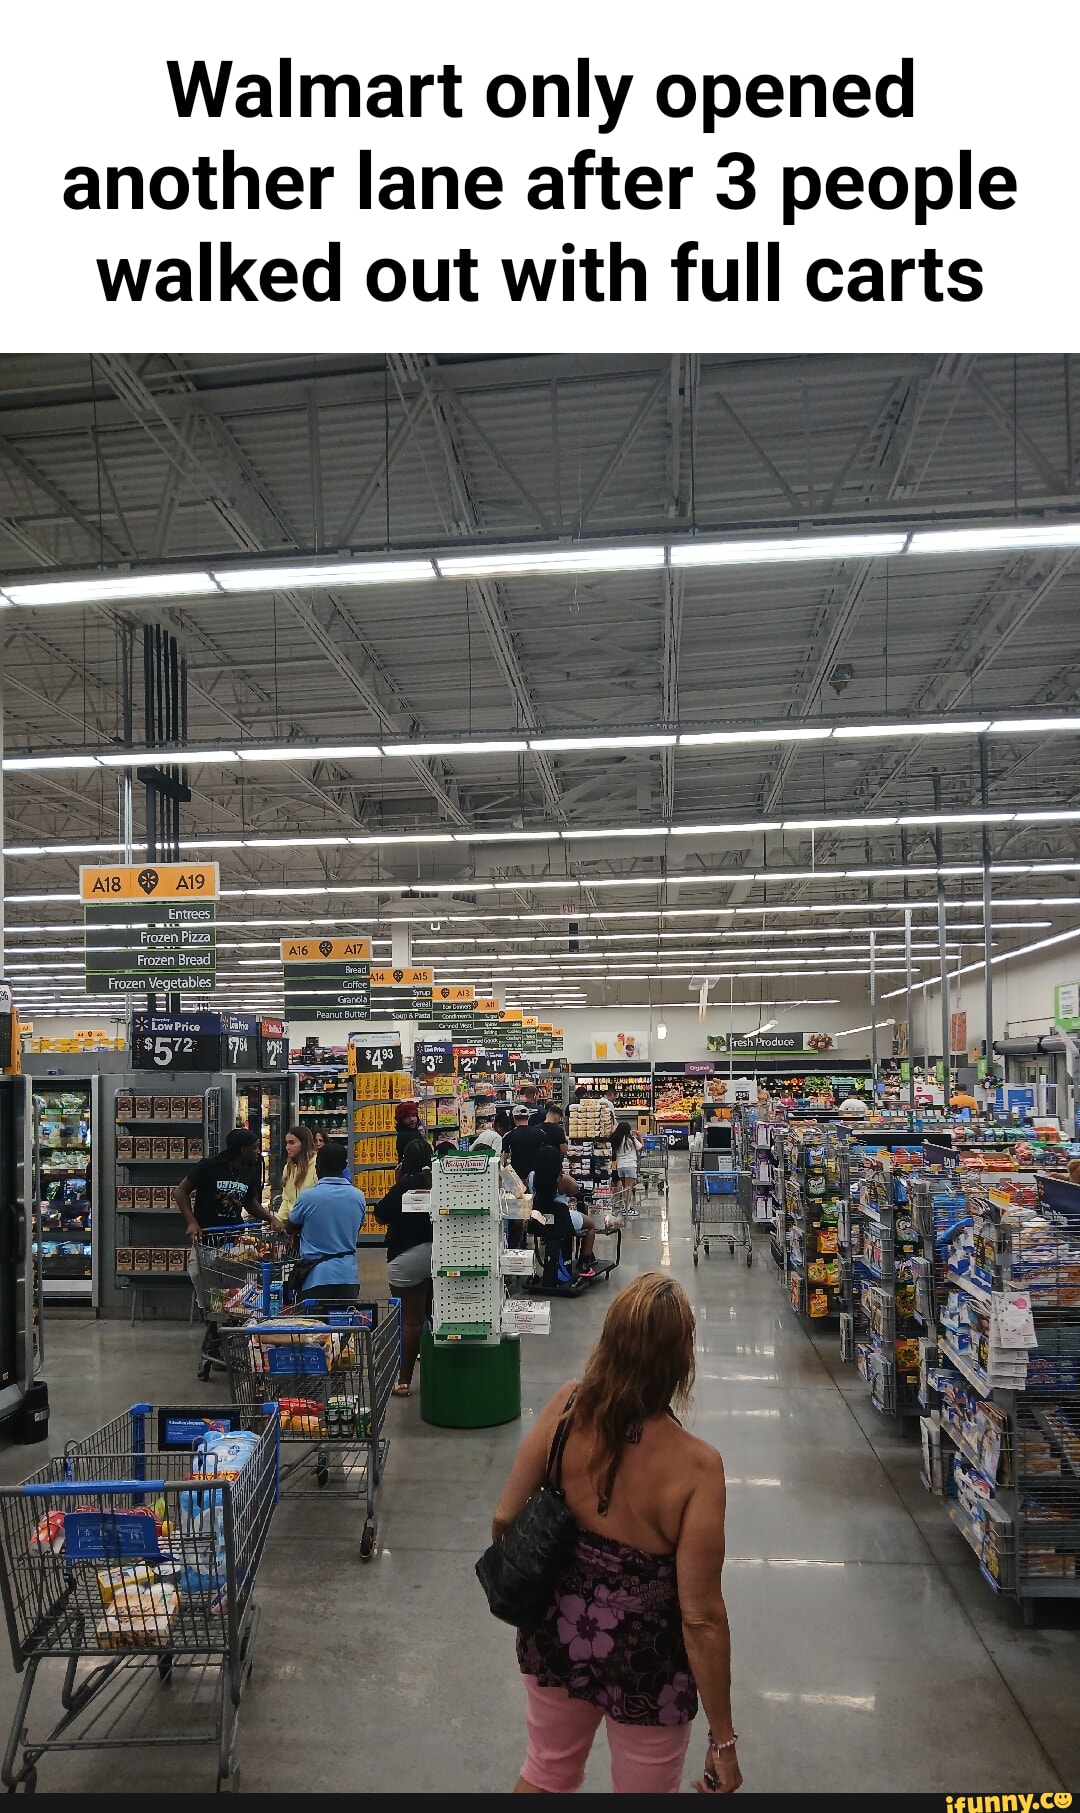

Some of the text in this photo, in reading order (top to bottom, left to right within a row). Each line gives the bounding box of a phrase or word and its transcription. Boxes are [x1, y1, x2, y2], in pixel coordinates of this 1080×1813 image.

[92, 874, 205, 892] A18 A19
[168, 908, 211, 920] Entrees
[140, 930, 211, 943] Frozen Pizza
[288, 943, 364, 956] A16 A17
[137, 953, 211, 966] Frozen Bread
[345, 965, 367, 974] Bread
[370, 972, 428, 982] A14 A15
[108, 977, 212, 992] Frozen Vegetables
[342, 980, 368, 989] Coffee
[412, 989, 431, 997] Syrup
[456, 989, 470, 997] A13
[337, 995, 368, 1004] Granola
[411, 1000, 431, 1008] Cereal
[316, 1010, 368, 1019] Peanut Butter
[391, 1012, 407, 1020] Soup
[151, 1022, 201, 1032] Low Price
[729, 1037, 795, 1047] Fresh Produce
